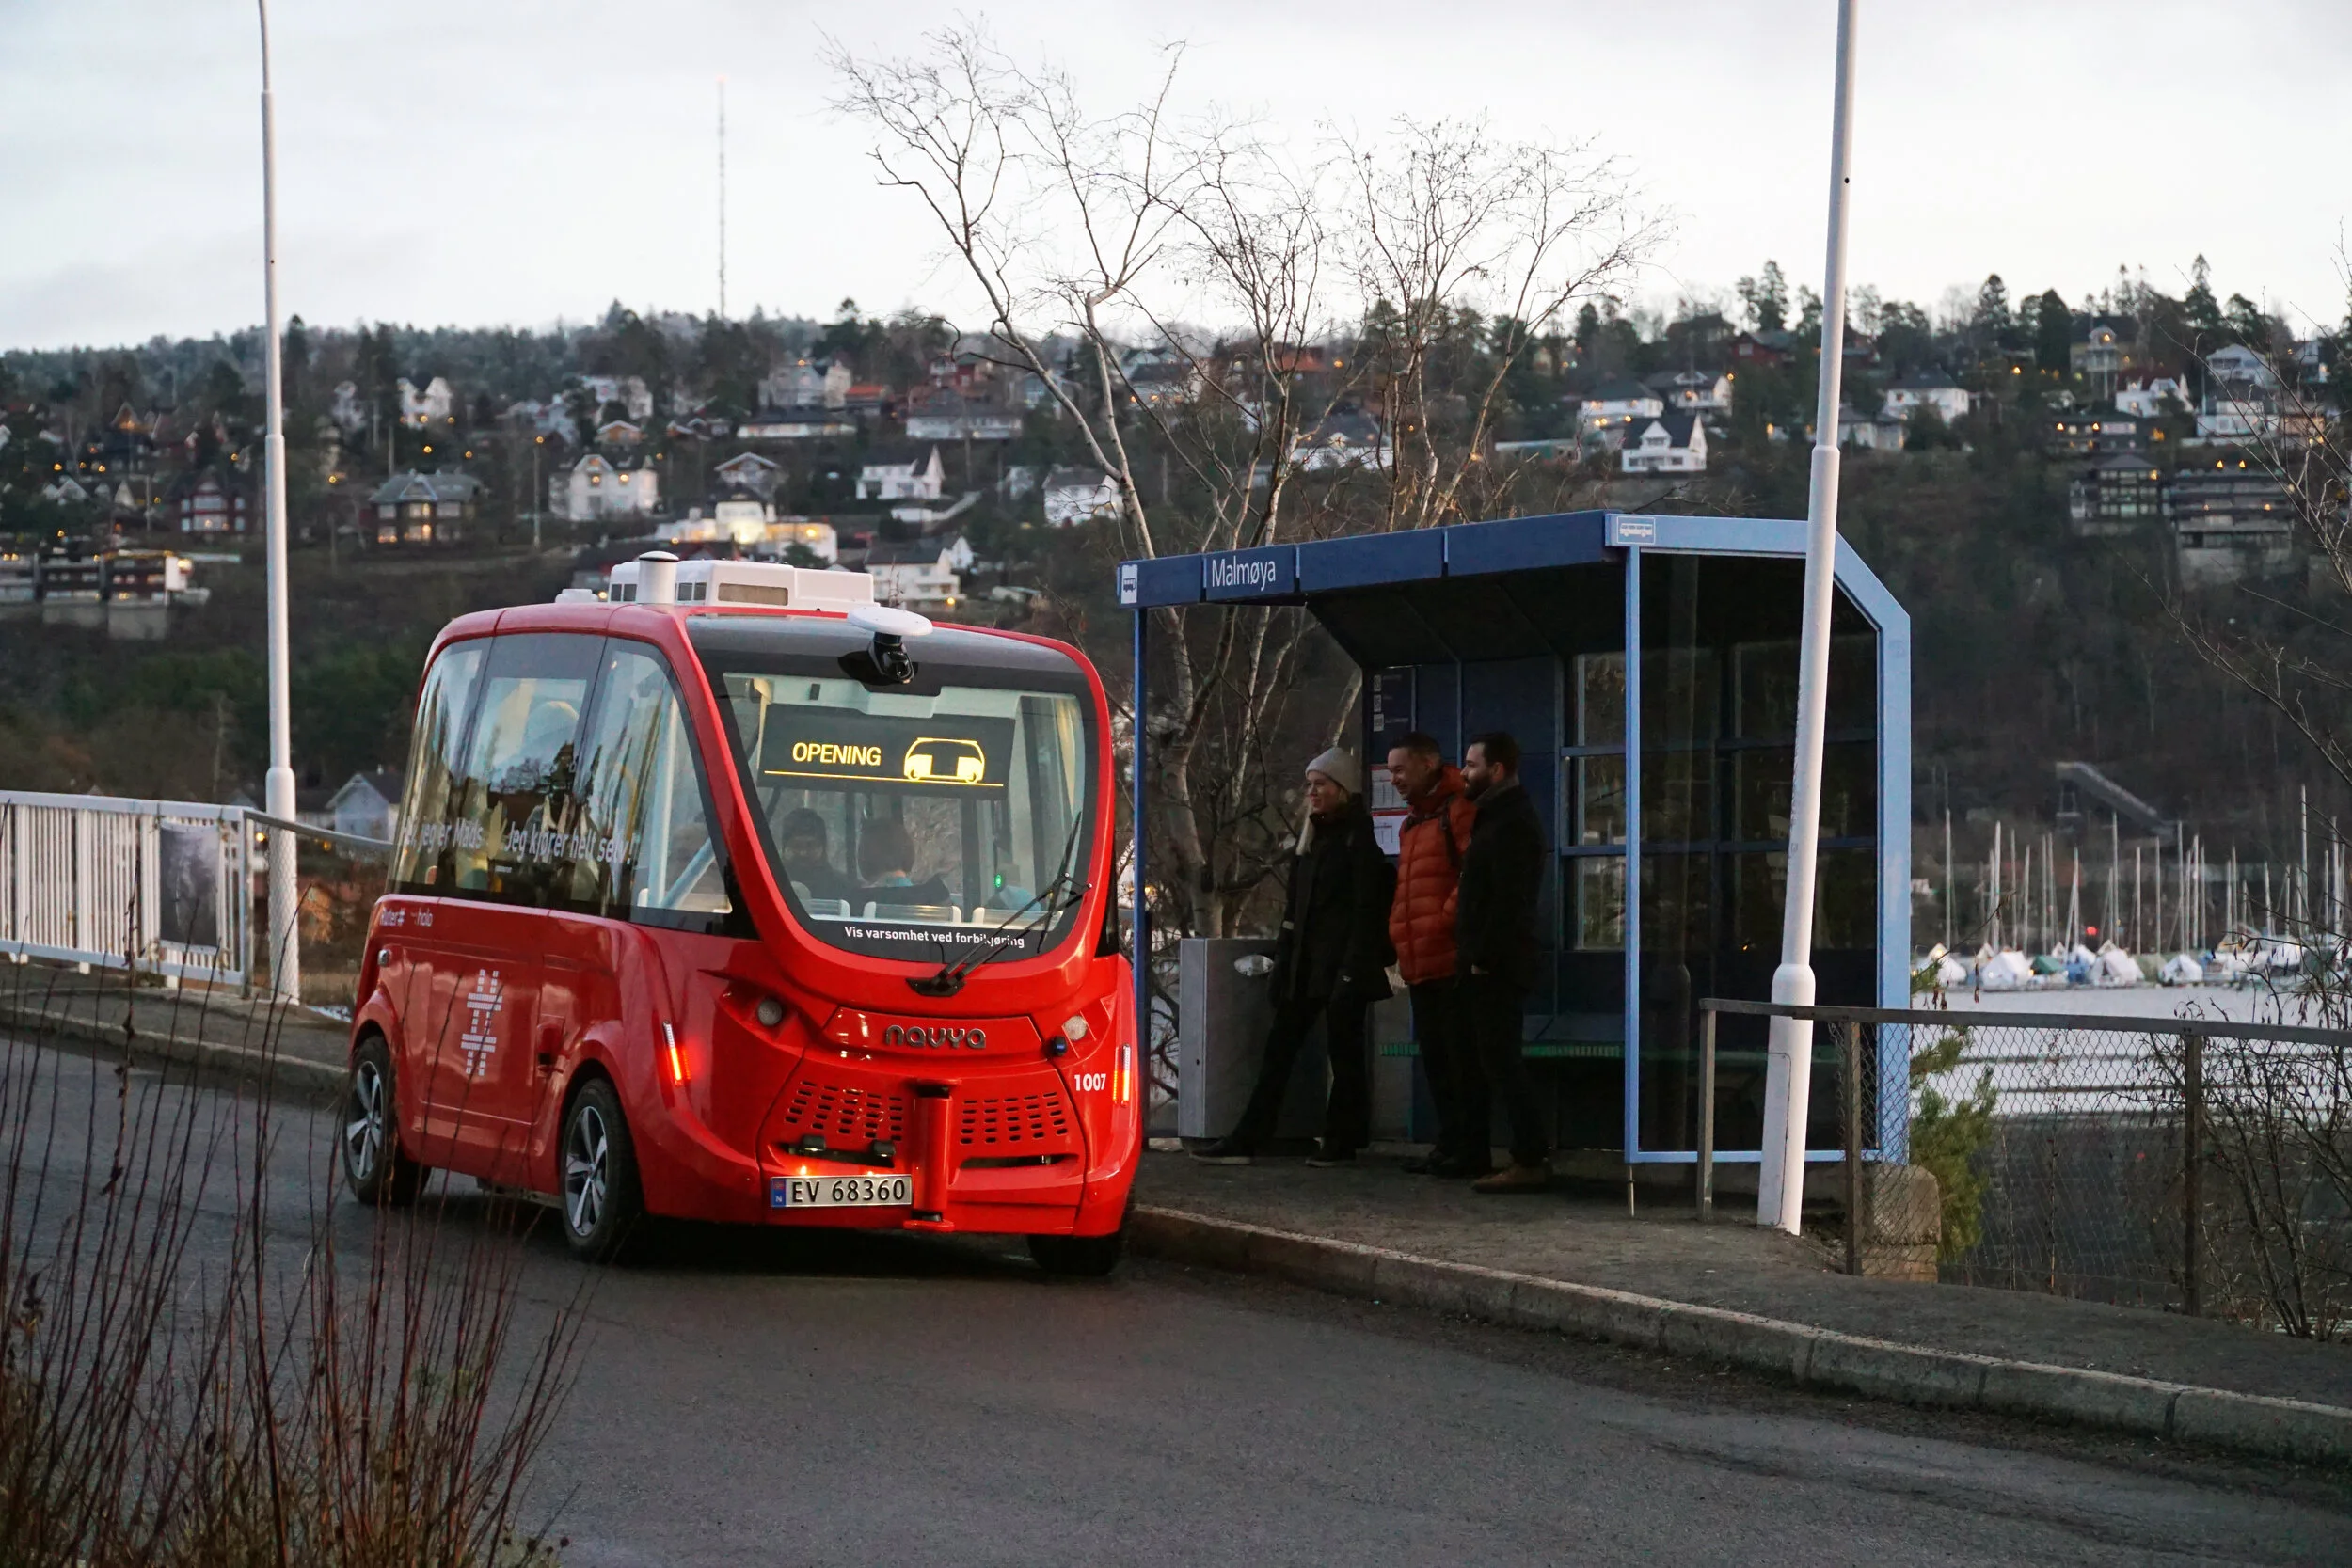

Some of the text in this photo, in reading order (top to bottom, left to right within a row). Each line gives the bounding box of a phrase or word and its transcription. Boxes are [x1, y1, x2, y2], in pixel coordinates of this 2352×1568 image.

[1212, 555, 1276, 592] Malmøya
[792, 742, 882, 767] OPENING
[503, 821, 528, 863] Jeg
[529, 822, 570, 863] kjører
[569, 827, 596, 860] helt
[844, 927, 864, 939] Vis
[866, 928, 930, 942] varsomhet
[931, 931, 953, 943] ved
[885, 1023, 987, 1050] navya
[1073, 1073, 1107, 1092] 1007
[791, 1179, 906, 1203] EV 68360
